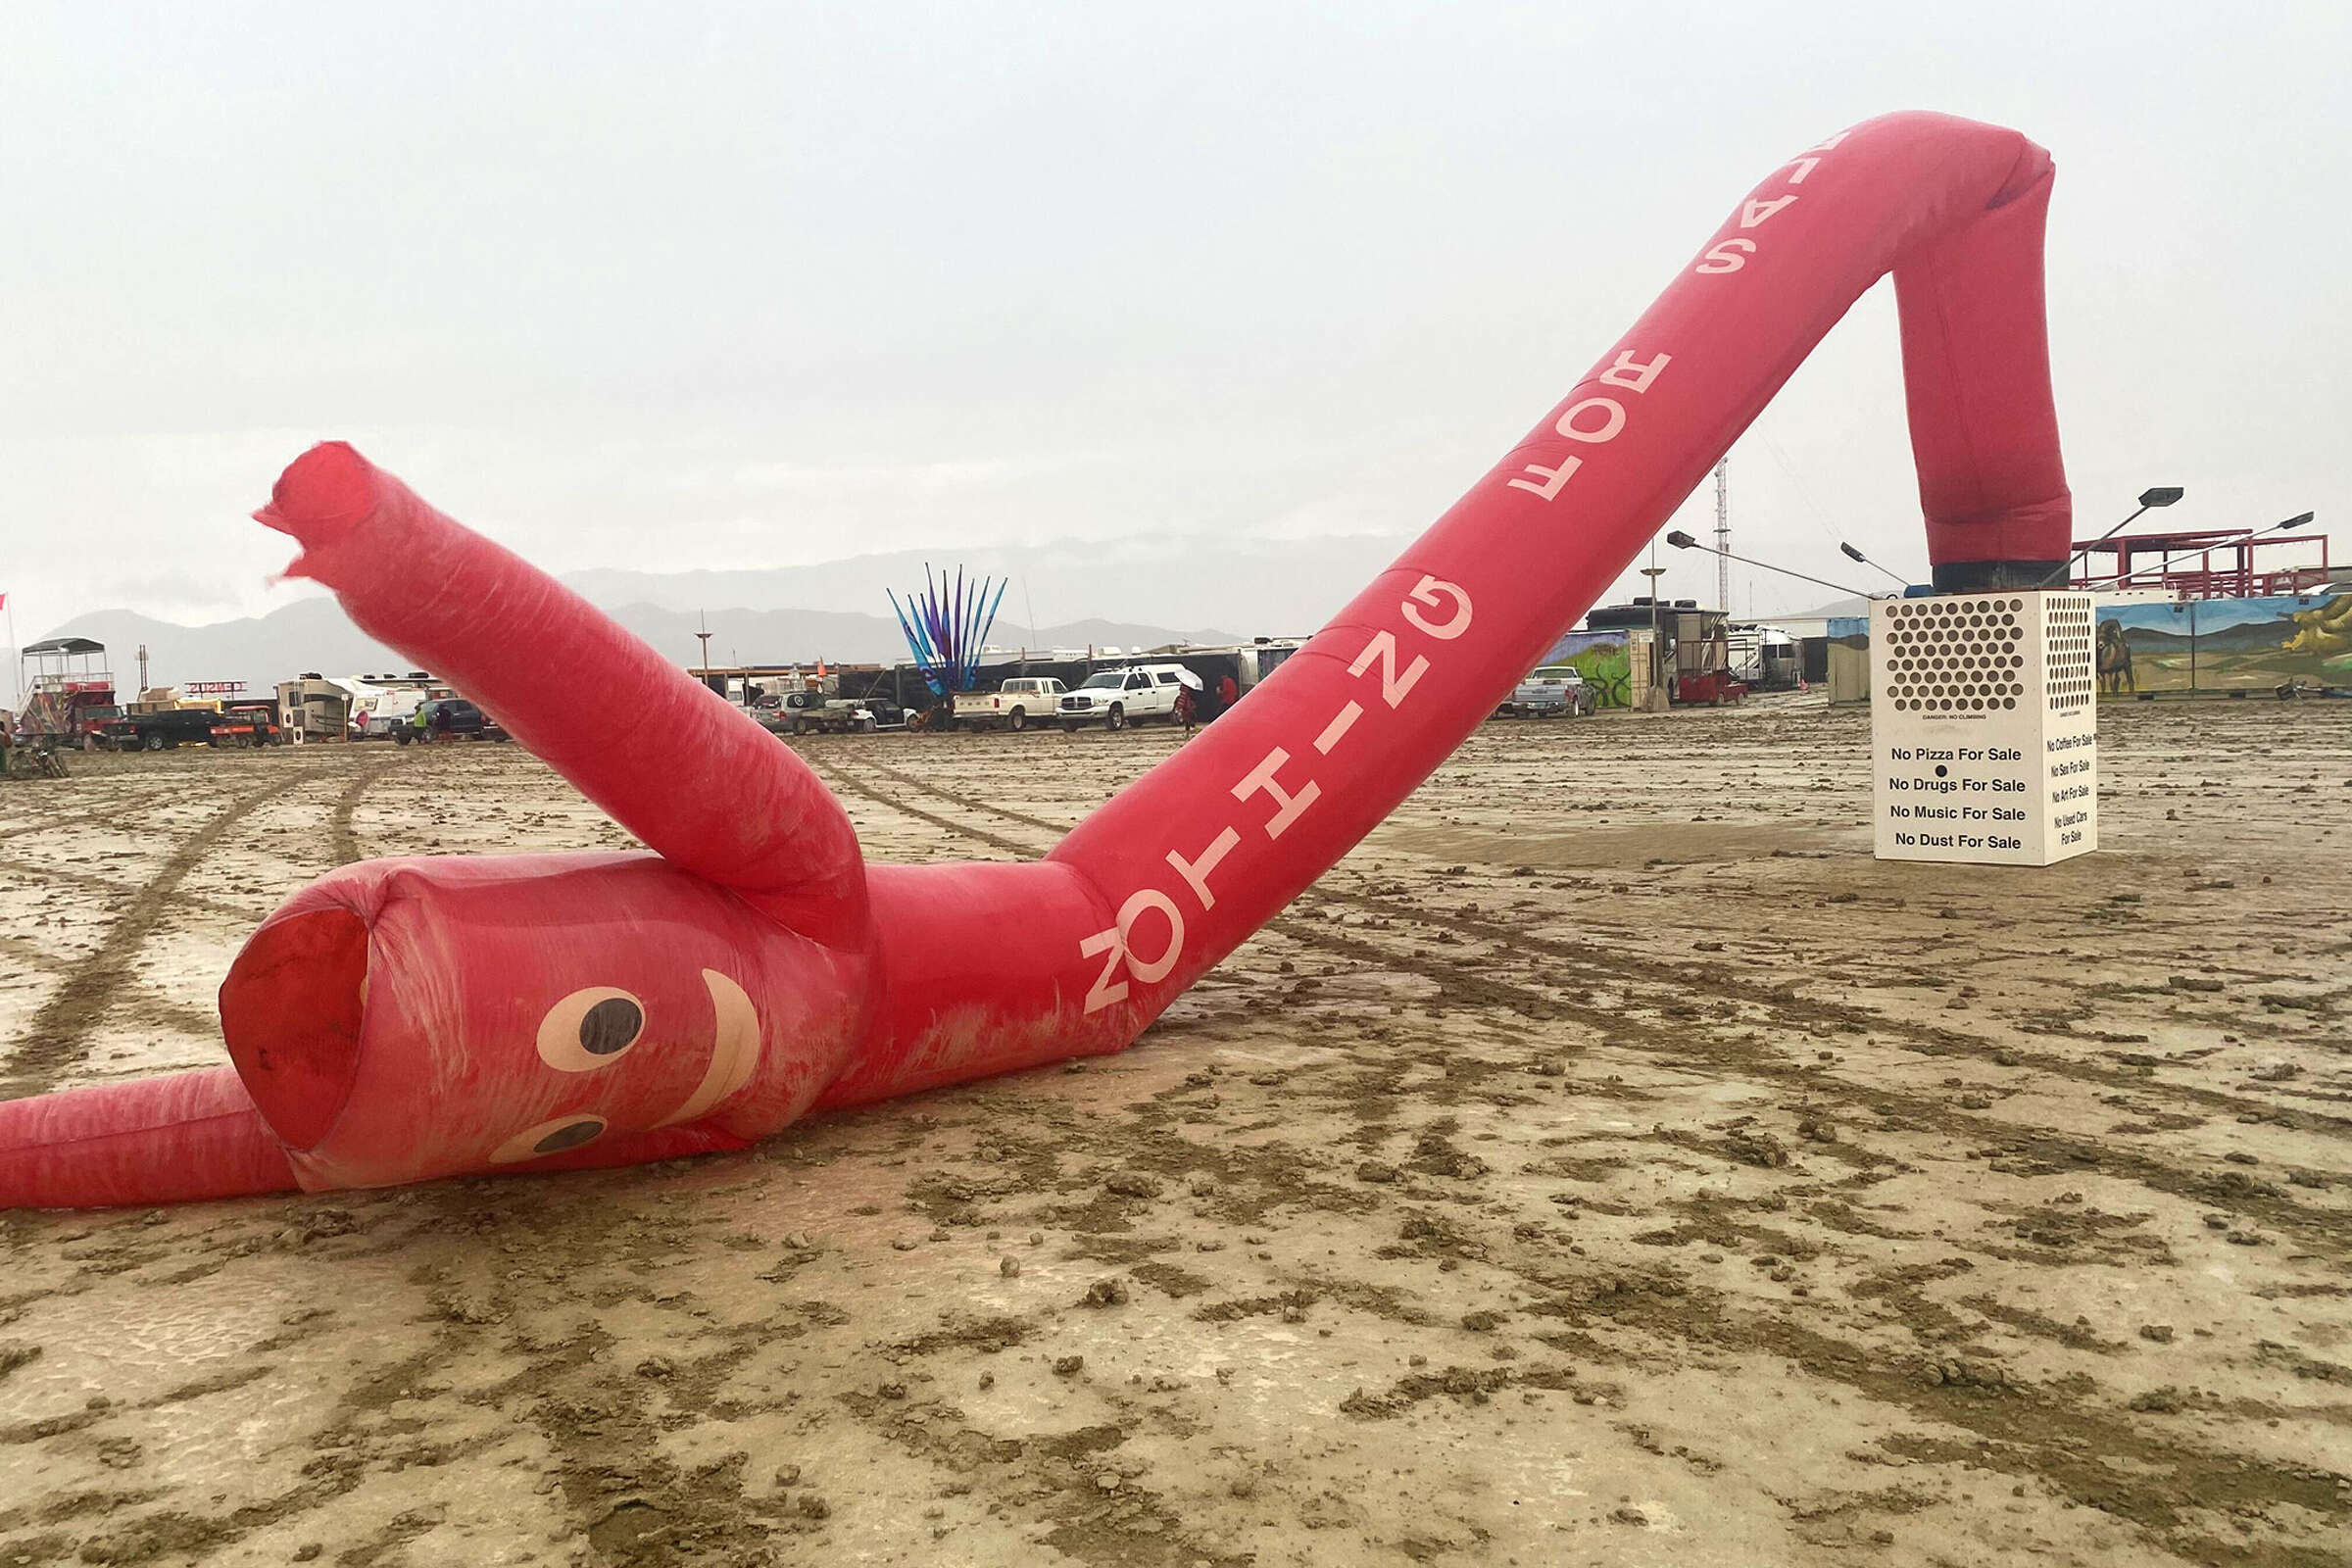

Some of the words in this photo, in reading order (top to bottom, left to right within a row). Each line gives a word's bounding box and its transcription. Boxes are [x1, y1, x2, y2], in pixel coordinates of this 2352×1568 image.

[1080, 574, 1473, 1014] NOTHING
[1507, 350, 1672, 501] FOR
[2047, 740, 2055, 752] No
[2056, 738, 2072, 751] Coffee
[2082, 734, 2092, 746] Sale
[1891, 748, 1911, 760] No
[1916, 748, 1953, 760] Pizza
[1958, 748, 1984, 760] For
[1987, 748, 2022, 760] Sale
[2051, 765, 2059, 777] No
[2060, 763, 2069, 776] Sex
[2070, 761, 2079, 774] For
[2080, 760, 2089, 771] Sale
[1889, 778, 1909, 790] No
[1914, 778, 1957, 794] Drugs
[1962, 779, 1987, 791] For
[1992, 779, 2026, 792] Sale
[2052, 791, 2060, 803] No
[2060, 789, 2069, 802] Art
[2079, 785, 2089, 798] Sale
[1890, 806, 1910, 817] No
[1914, 806, 1957, 819] Music
[1962, 808, 1987, 819] For
[1992, 808, 2026, 820] Sale
[2054, 816, 2062, 828] No
[2063, 813, 2075, 826] Used
[2076, 810, 2087, 823] Cars
[1895, 833, 1915, 845] No
[1920, 833, 1953, 847] Dust
[1958, 835, 1984, 848] For
[1987, 836, 2022, 849] Sale
[2061, 832, 2070, 845] For
[2071, 830, 2082, 843] Sale
